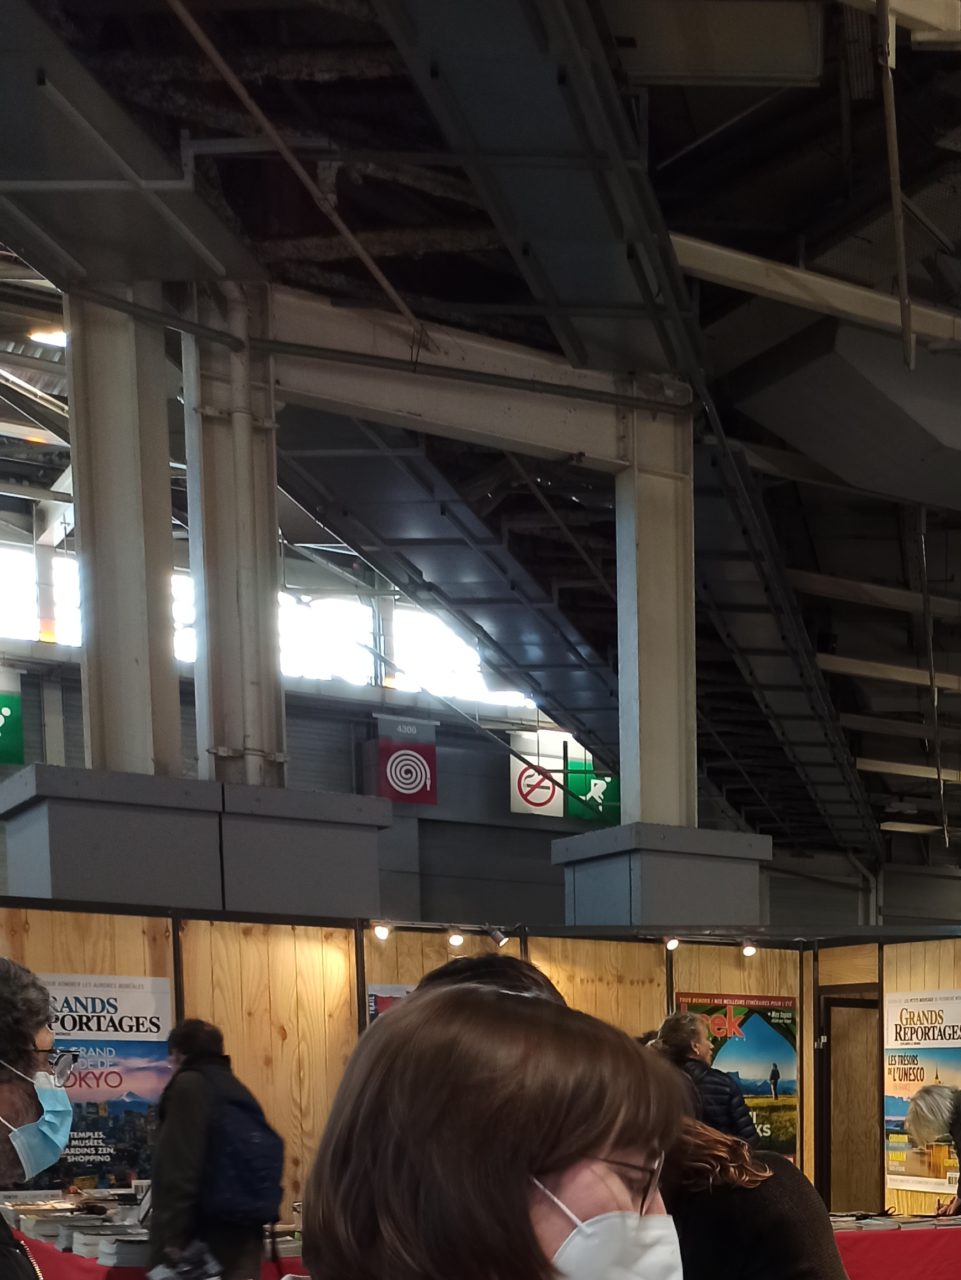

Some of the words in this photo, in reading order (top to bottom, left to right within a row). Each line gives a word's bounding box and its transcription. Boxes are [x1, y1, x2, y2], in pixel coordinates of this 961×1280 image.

[899, 1008, 944, 1026] GRANDS
[887, 1055, 897, 1066] LES
[897, 1052, 918, 1066] TRÉSORS
[67, 1155, 111, 1163] SHOPPING
